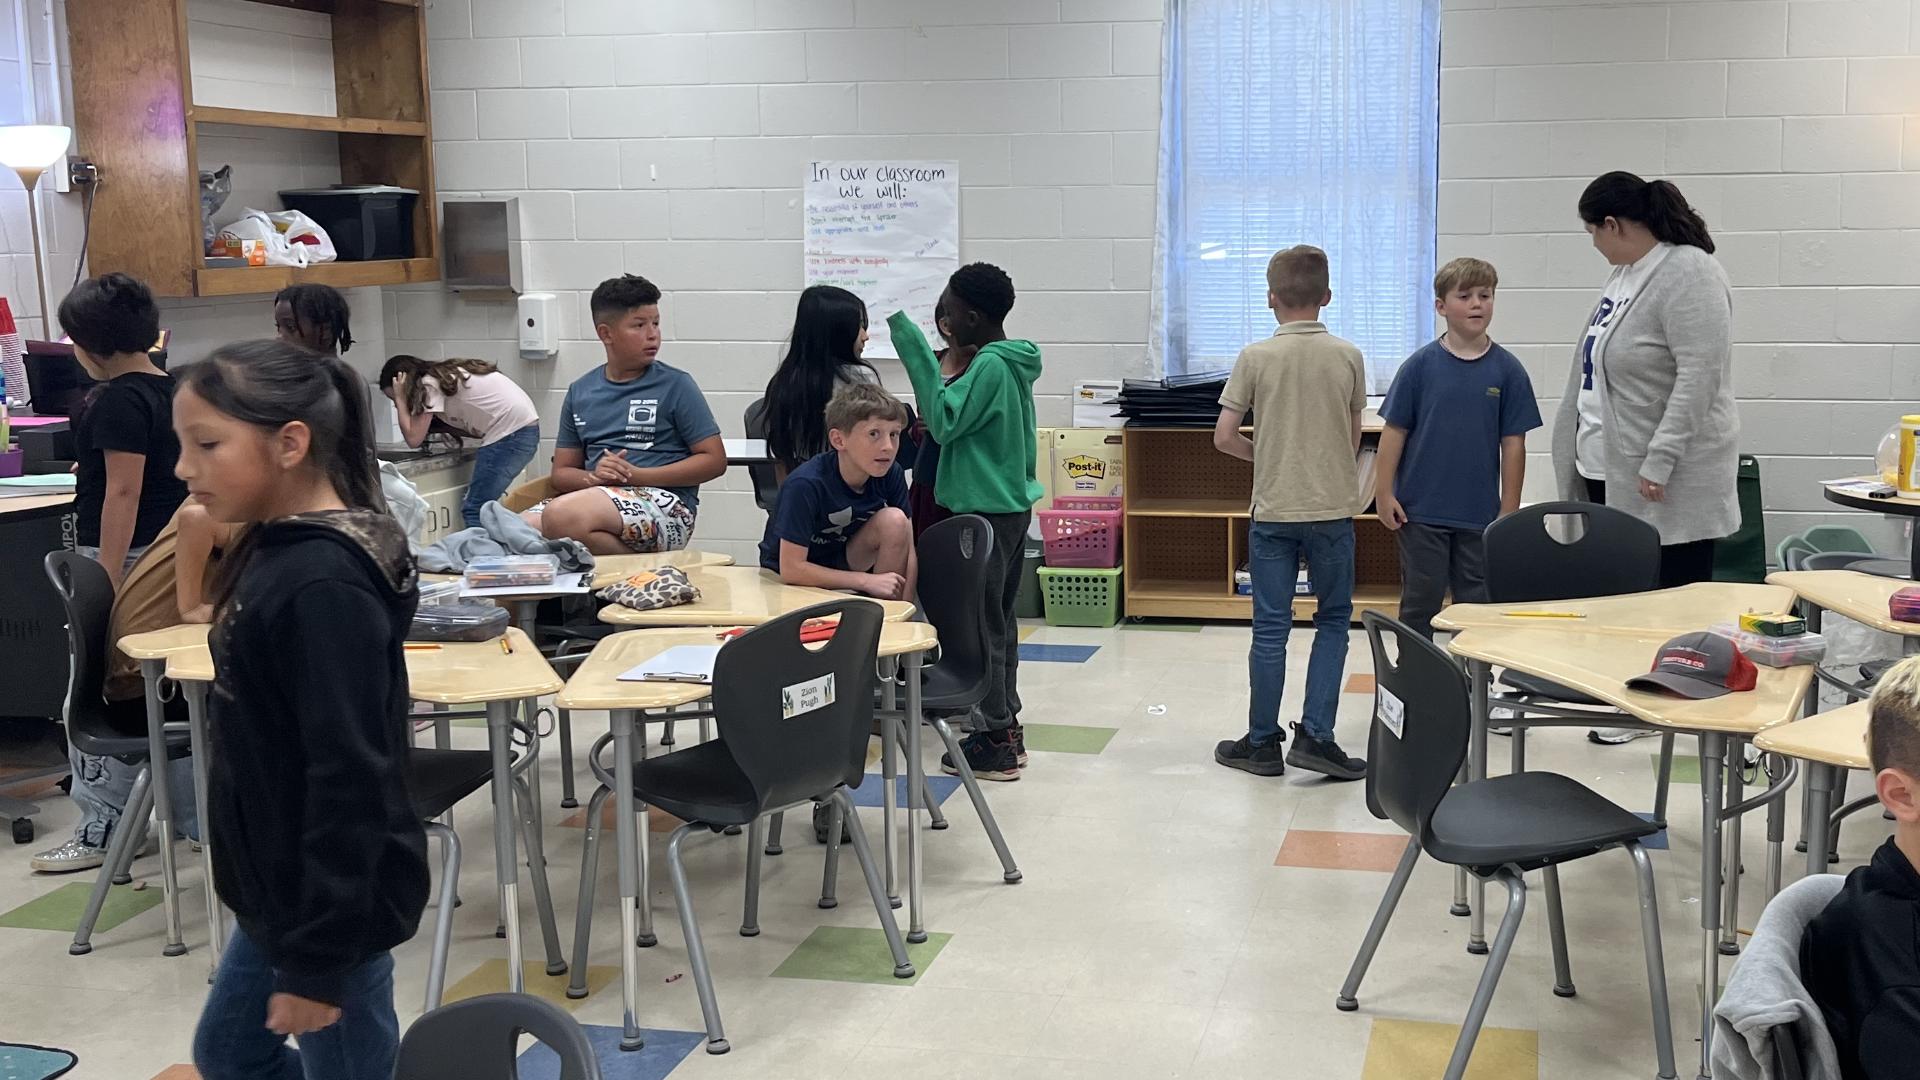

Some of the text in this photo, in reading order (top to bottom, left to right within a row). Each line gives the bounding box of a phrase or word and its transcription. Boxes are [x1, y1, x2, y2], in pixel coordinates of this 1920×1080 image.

[811, 162, 945, 182] In our classroom
[839, 182, 907, 200] we will:
[1068, 462, 1102, 471] Post-it
[801, 687, 817, 697] Zion
[801, 696, 819, 708] Pugh
